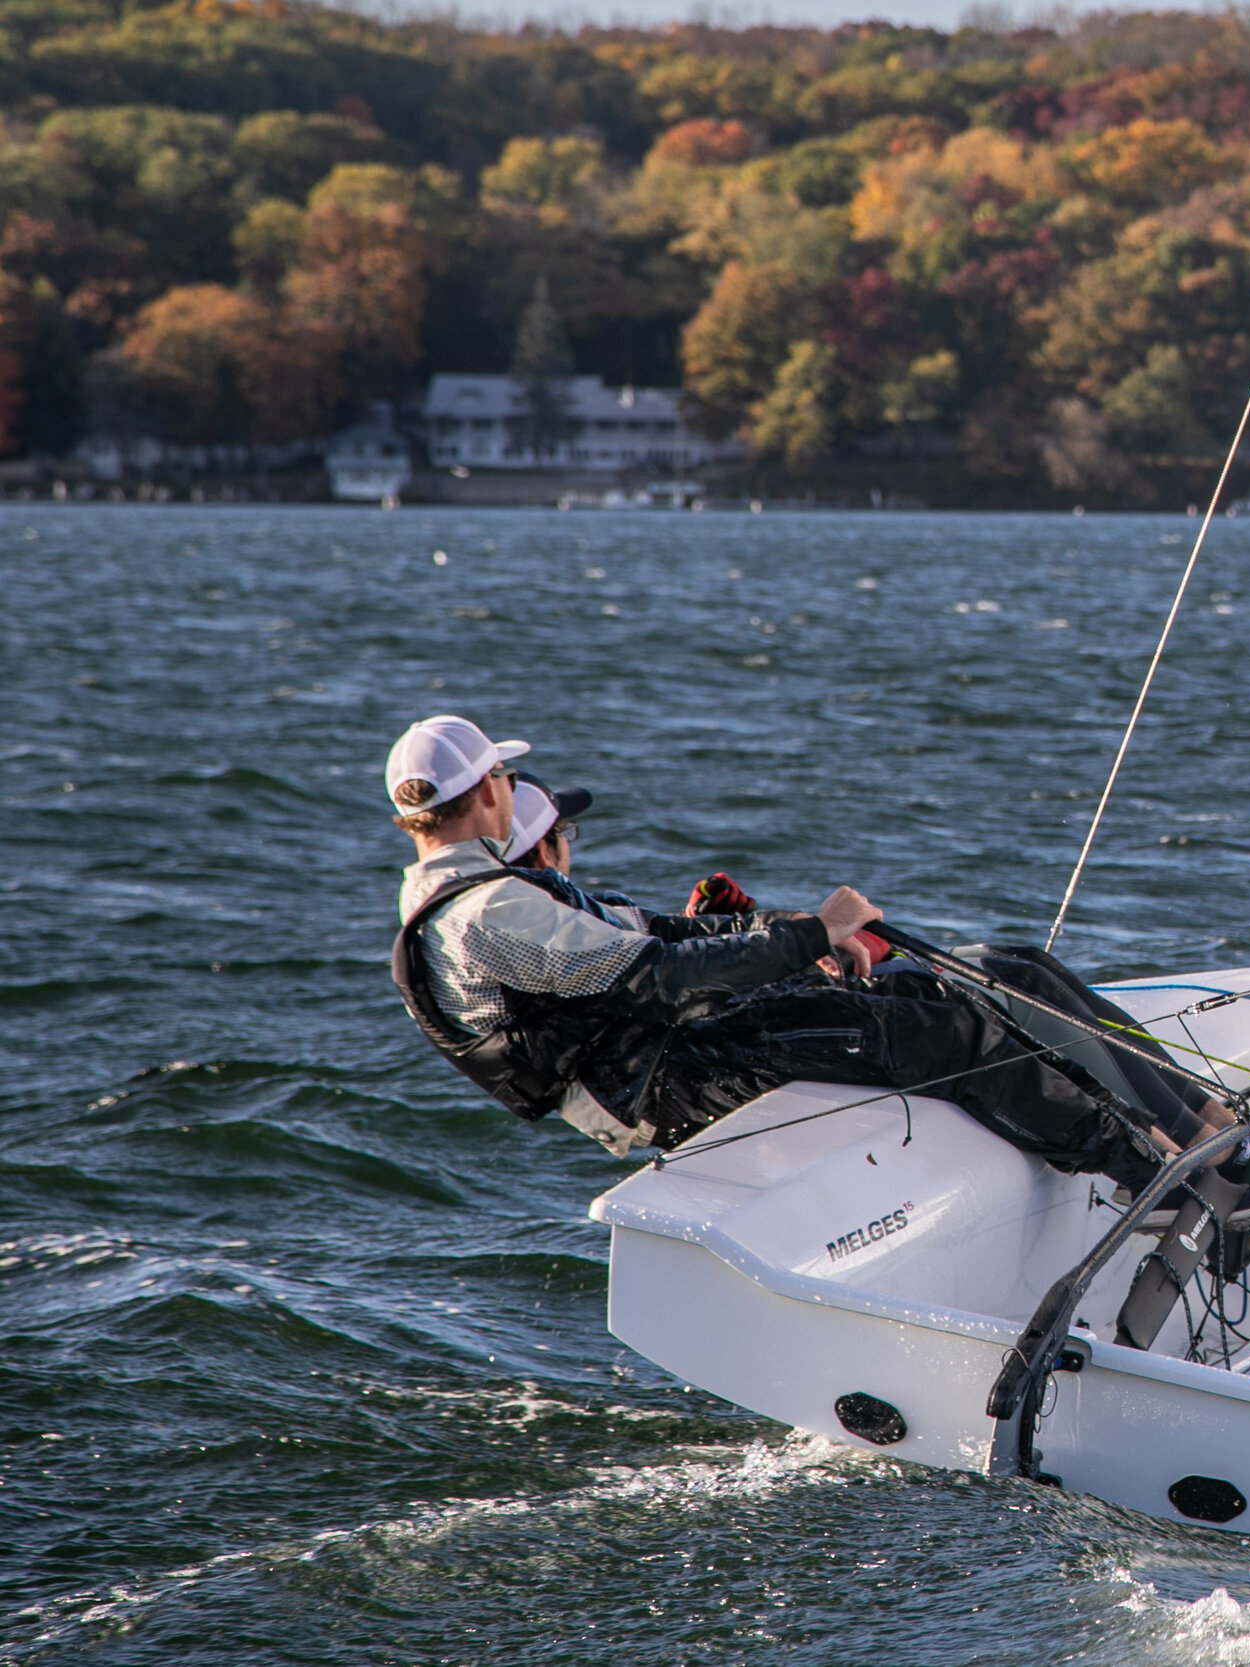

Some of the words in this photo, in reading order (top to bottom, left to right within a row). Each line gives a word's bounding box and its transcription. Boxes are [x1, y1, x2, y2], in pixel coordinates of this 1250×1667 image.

[826, 1209, 908, 1262] MELGES
[902, 1200, 915, 1212] 15
[1190, 1209, 1210, 1240] MELGE
